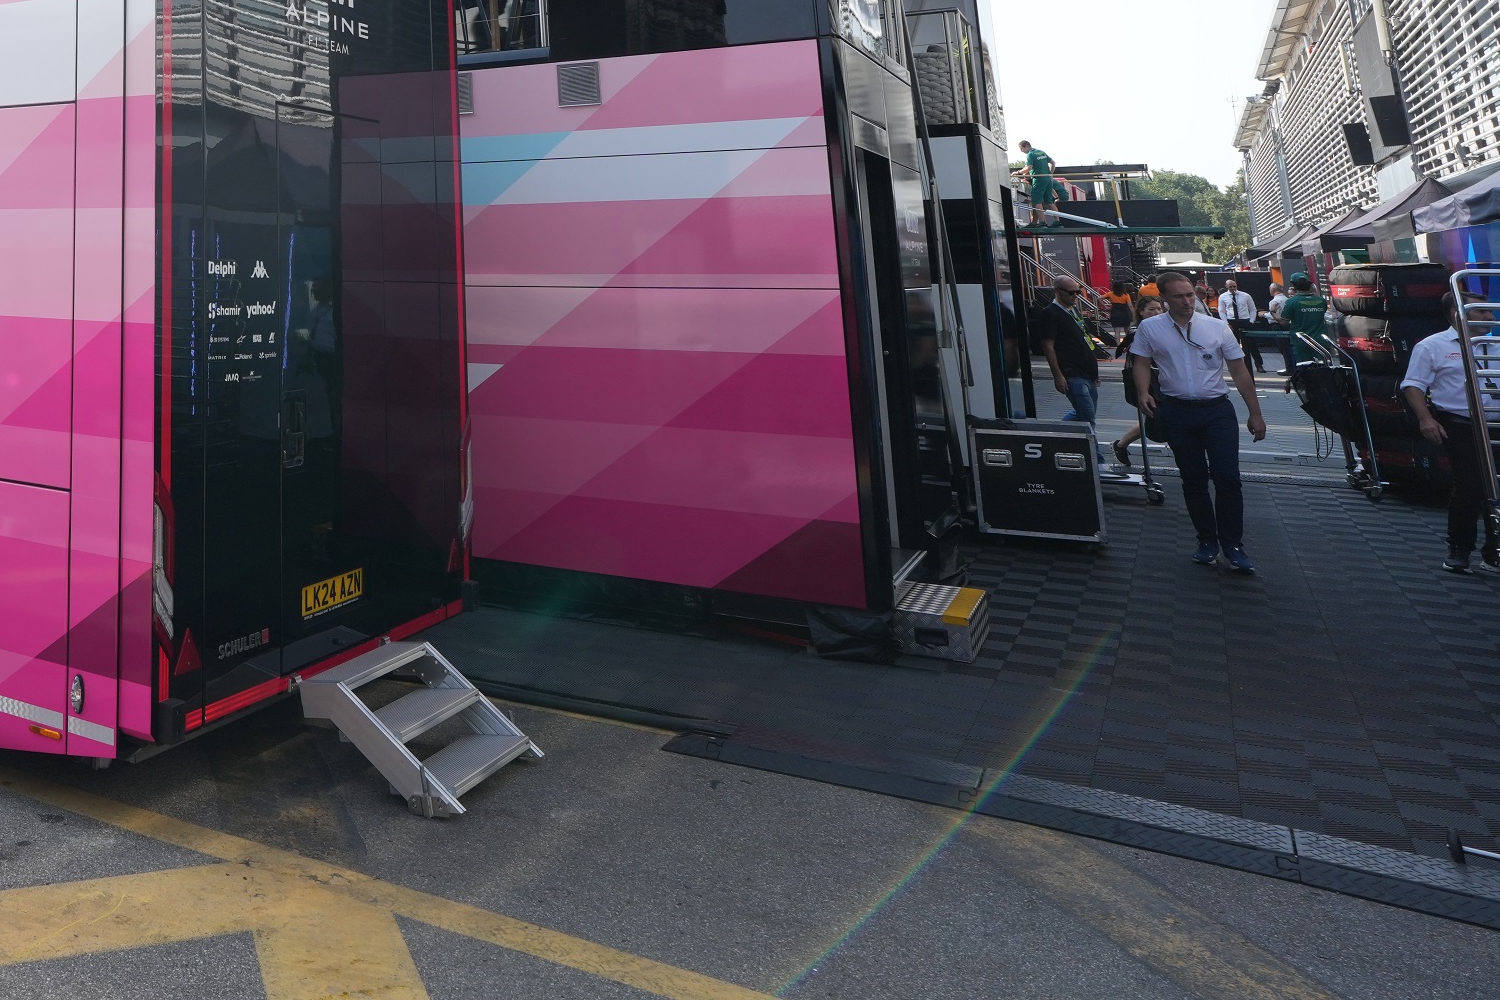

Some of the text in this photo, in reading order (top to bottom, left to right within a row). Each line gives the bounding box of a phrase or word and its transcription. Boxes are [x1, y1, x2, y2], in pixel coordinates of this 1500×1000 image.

[285, 2, 369, 39] ALPINE
[325, 39, 349, 55] TEAM
[208, 261, 236, 278] Delphi
[216, 301, 276, 319] shamir yahoo!
[1024, 443, 1043, 459] S
[304, 579, 336, 613] LK24
[340, 570, 361, 600] AZN
[218, 631, 262, 660] SCHULER
